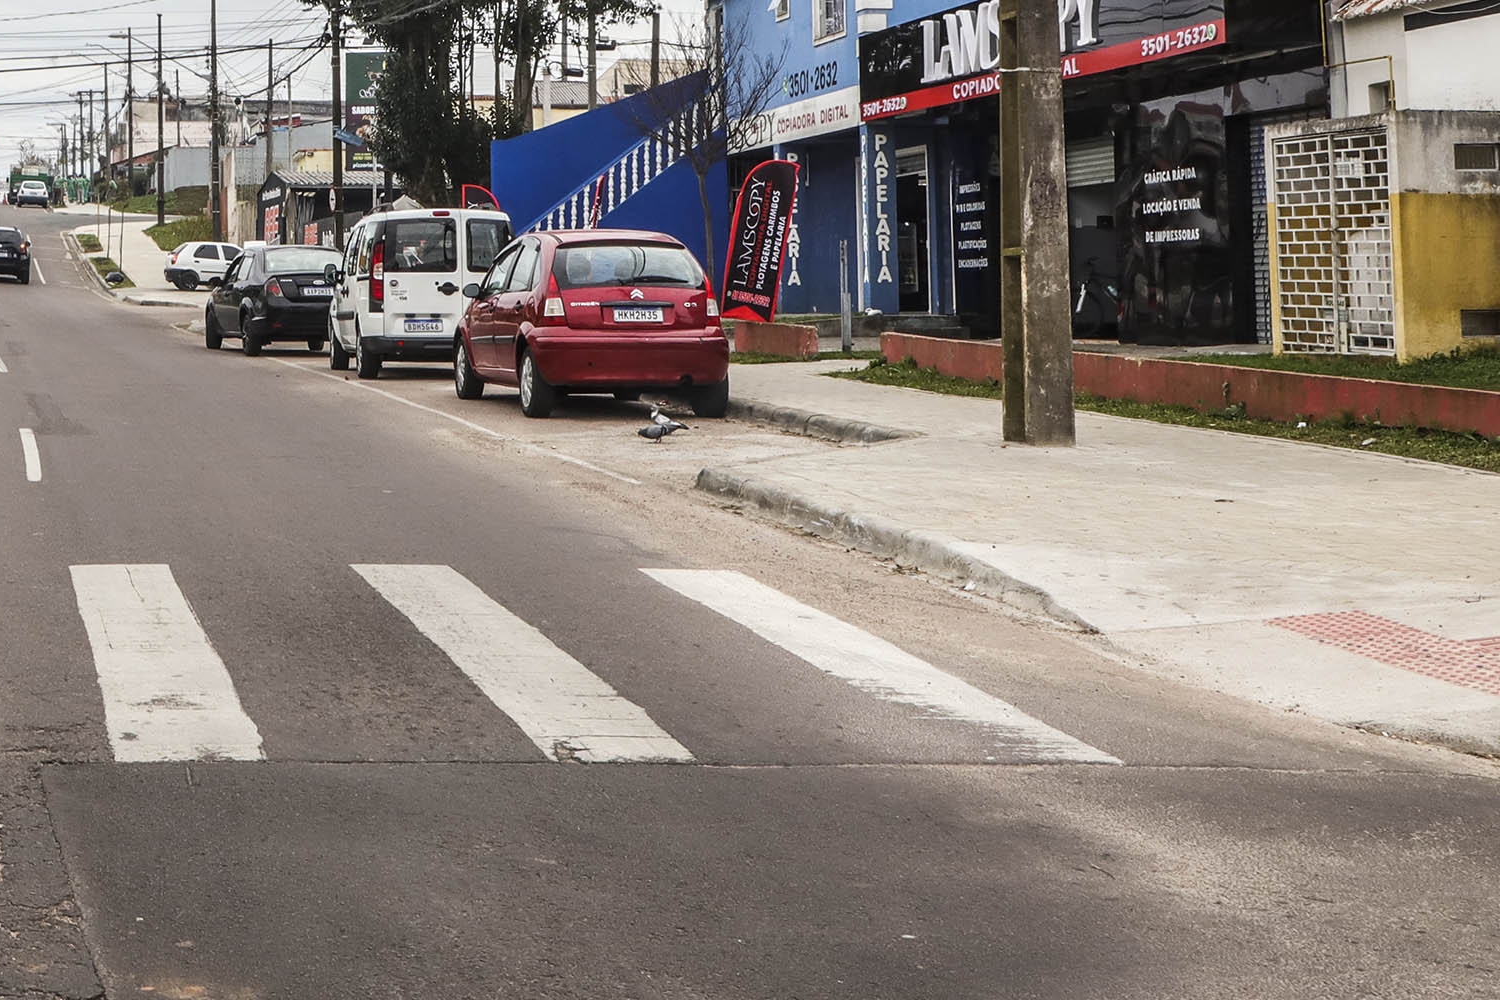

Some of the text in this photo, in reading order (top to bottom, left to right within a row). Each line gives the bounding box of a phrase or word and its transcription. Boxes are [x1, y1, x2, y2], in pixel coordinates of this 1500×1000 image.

[1141, 26, 1209, 57] 3501-2632
[777, 111, 816, 135] COPIADORA
[820, 104, 849, 124] DIGITAL
[863, 98, 902, 117] 3501-2632
[1144, 165, 1197, 185] GRÁFICA RÁPIDA
[873, 134, 893, 283] PAPELARIA
[1142, 197, 1201, 216] LOCAÇÃO E VENDA
[733, 176, 766, 286] LAMSCOPY
[755, 190, 781, 290] PLOTAGENS CARIMBOS
[770, 216, 787, 271] E PAPELARIA
[1145, 228, 1200, 243] DE IMPRESSORAS
[617, 310, 658, 321] HKH2H35
